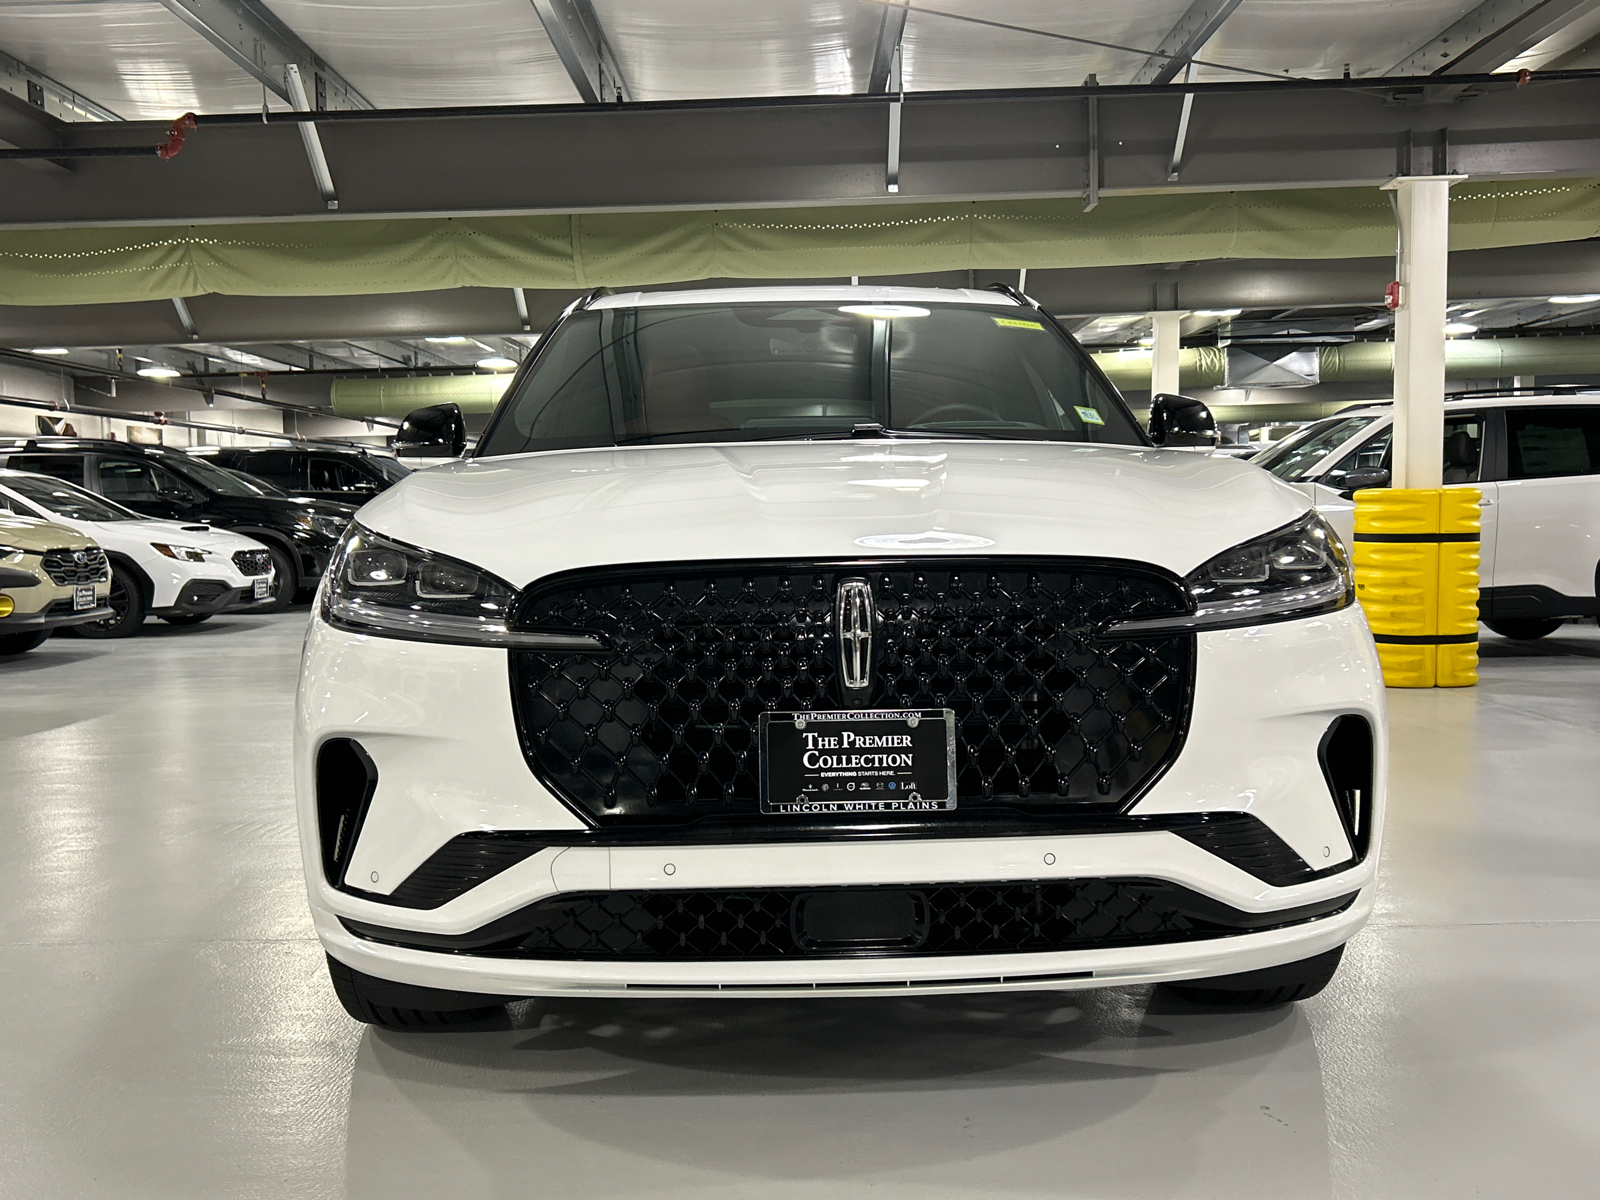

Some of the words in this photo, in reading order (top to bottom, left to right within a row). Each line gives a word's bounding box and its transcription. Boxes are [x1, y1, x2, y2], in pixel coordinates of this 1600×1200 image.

[803, 733, 838, 749] THE
[842, 732, 913, 748] PREMIER
[803, 751, 913, 769] COLLECTION
[780, 803, 837, 813] LINCOLN
[844, 802, 885, 811] WHITE
[892, 801, 938, 811] PLAINS
